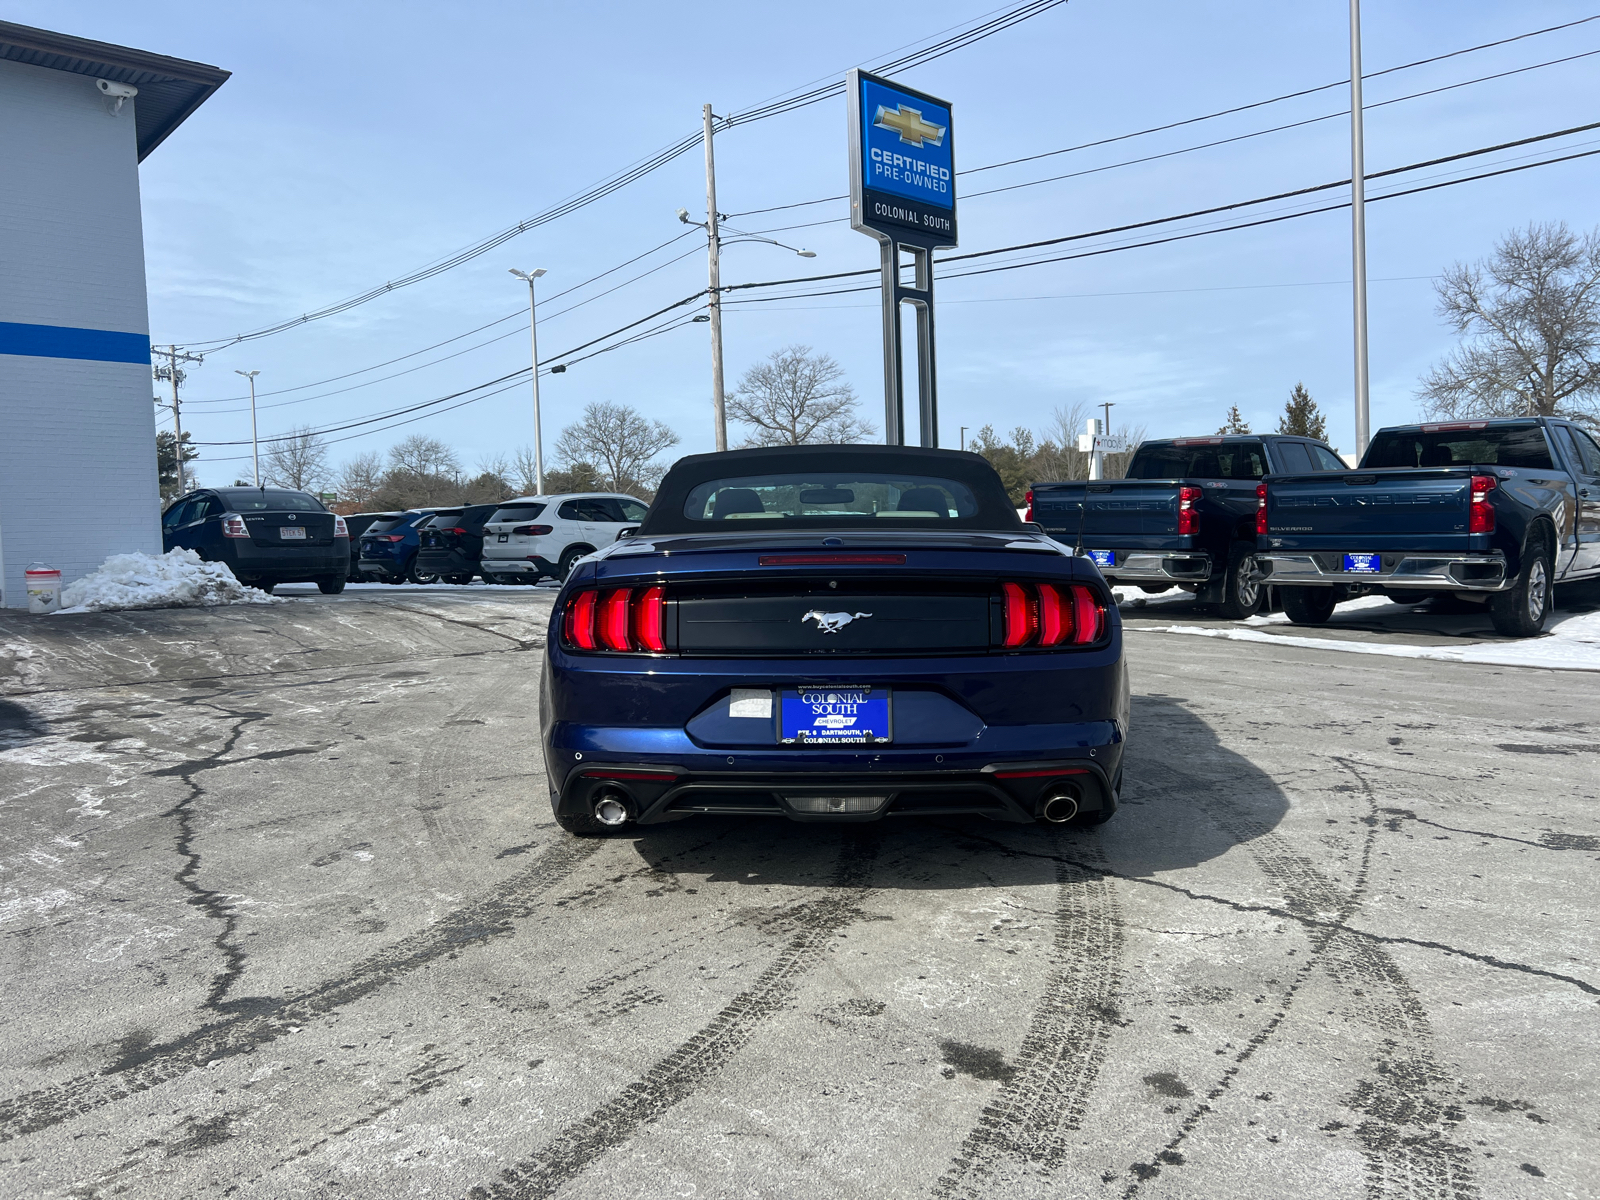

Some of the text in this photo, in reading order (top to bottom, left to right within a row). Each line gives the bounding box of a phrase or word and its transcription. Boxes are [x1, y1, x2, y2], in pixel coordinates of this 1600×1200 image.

[871, 147, 950, 181] CERTIFIED
[875, 163, 947, 193] PRE-OWNED
[875, 202, 950, 231] COLONIAL SOUTH
[1278, 494, 1453, 507] CHEVROLET
[802, 693, 868, 704] COLONIAL
[812, 704, 858, 715] SOUTH
